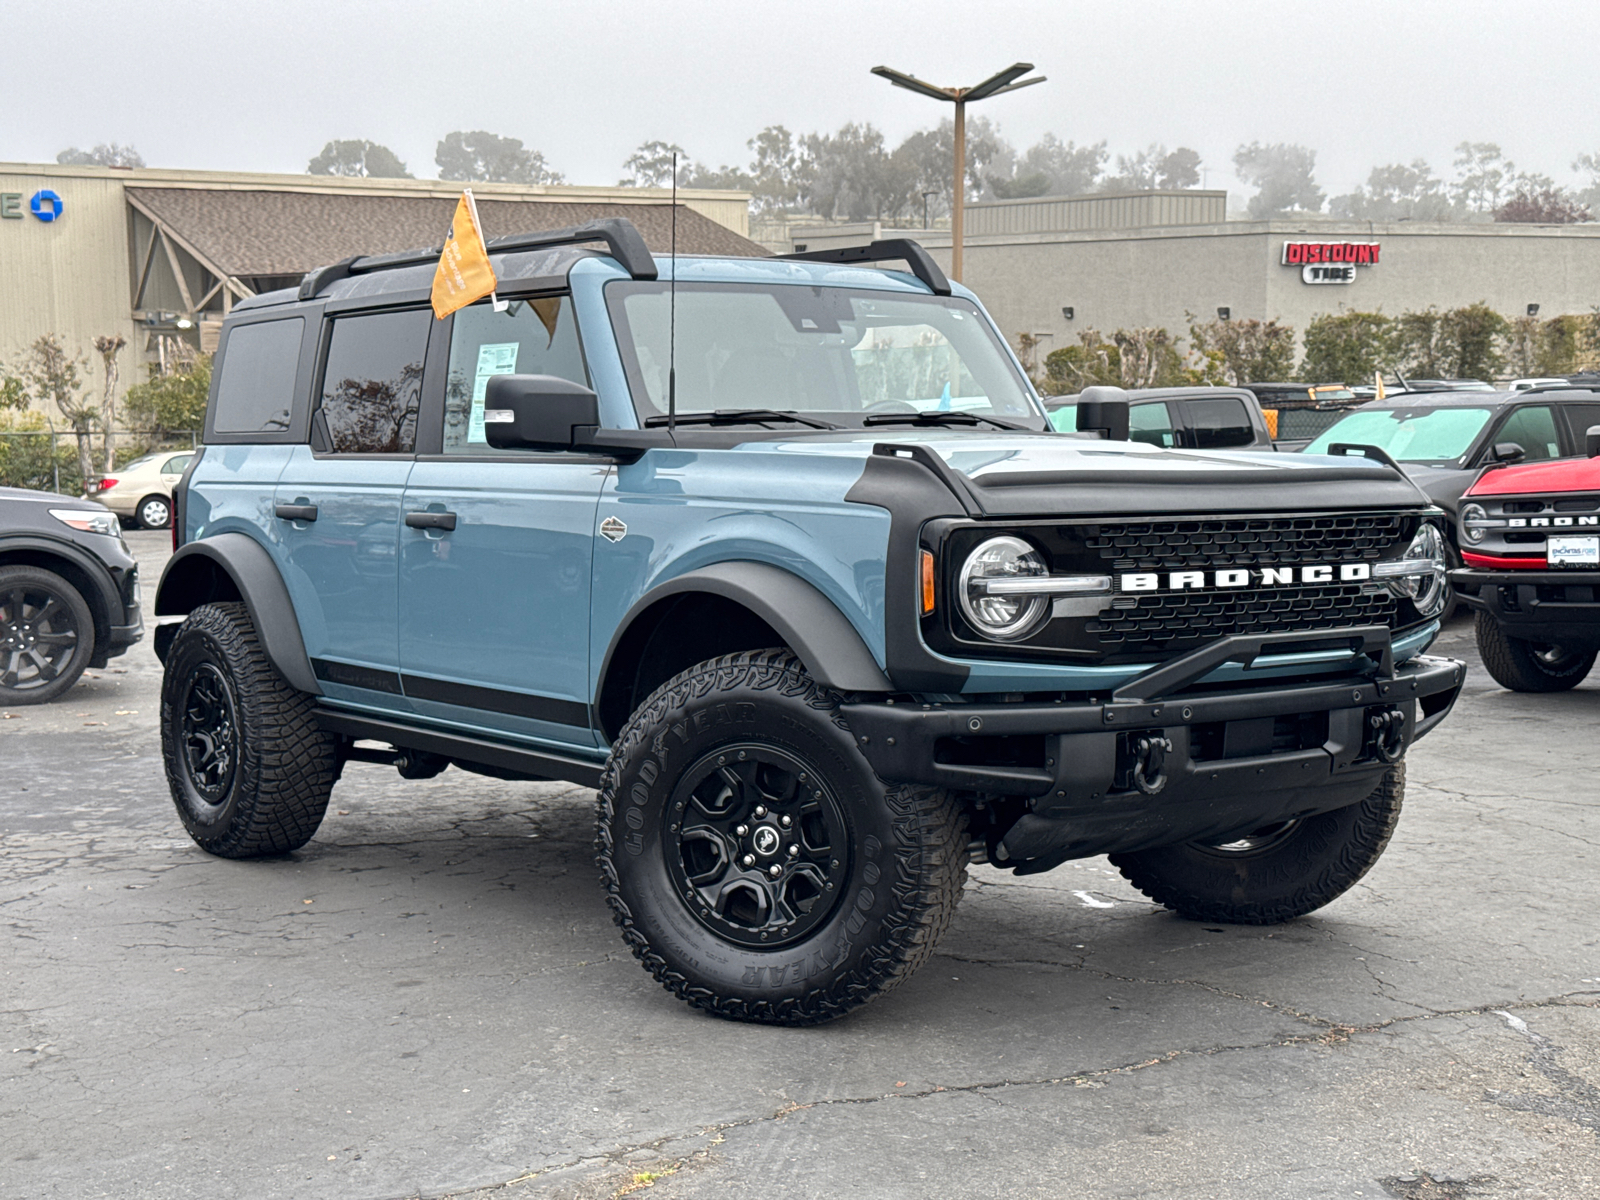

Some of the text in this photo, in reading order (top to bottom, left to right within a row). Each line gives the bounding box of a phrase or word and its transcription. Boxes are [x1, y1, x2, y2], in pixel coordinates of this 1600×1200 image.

[1285, 243, 1380, 264] DISCOUNT
[1311, 267, 1353, 280] TIRE
[1509, 516, 1598, 528] BRON
[1120, 563, 1370, 592] BRONCO
[624, 701, 758, 857] GOODYEAR
